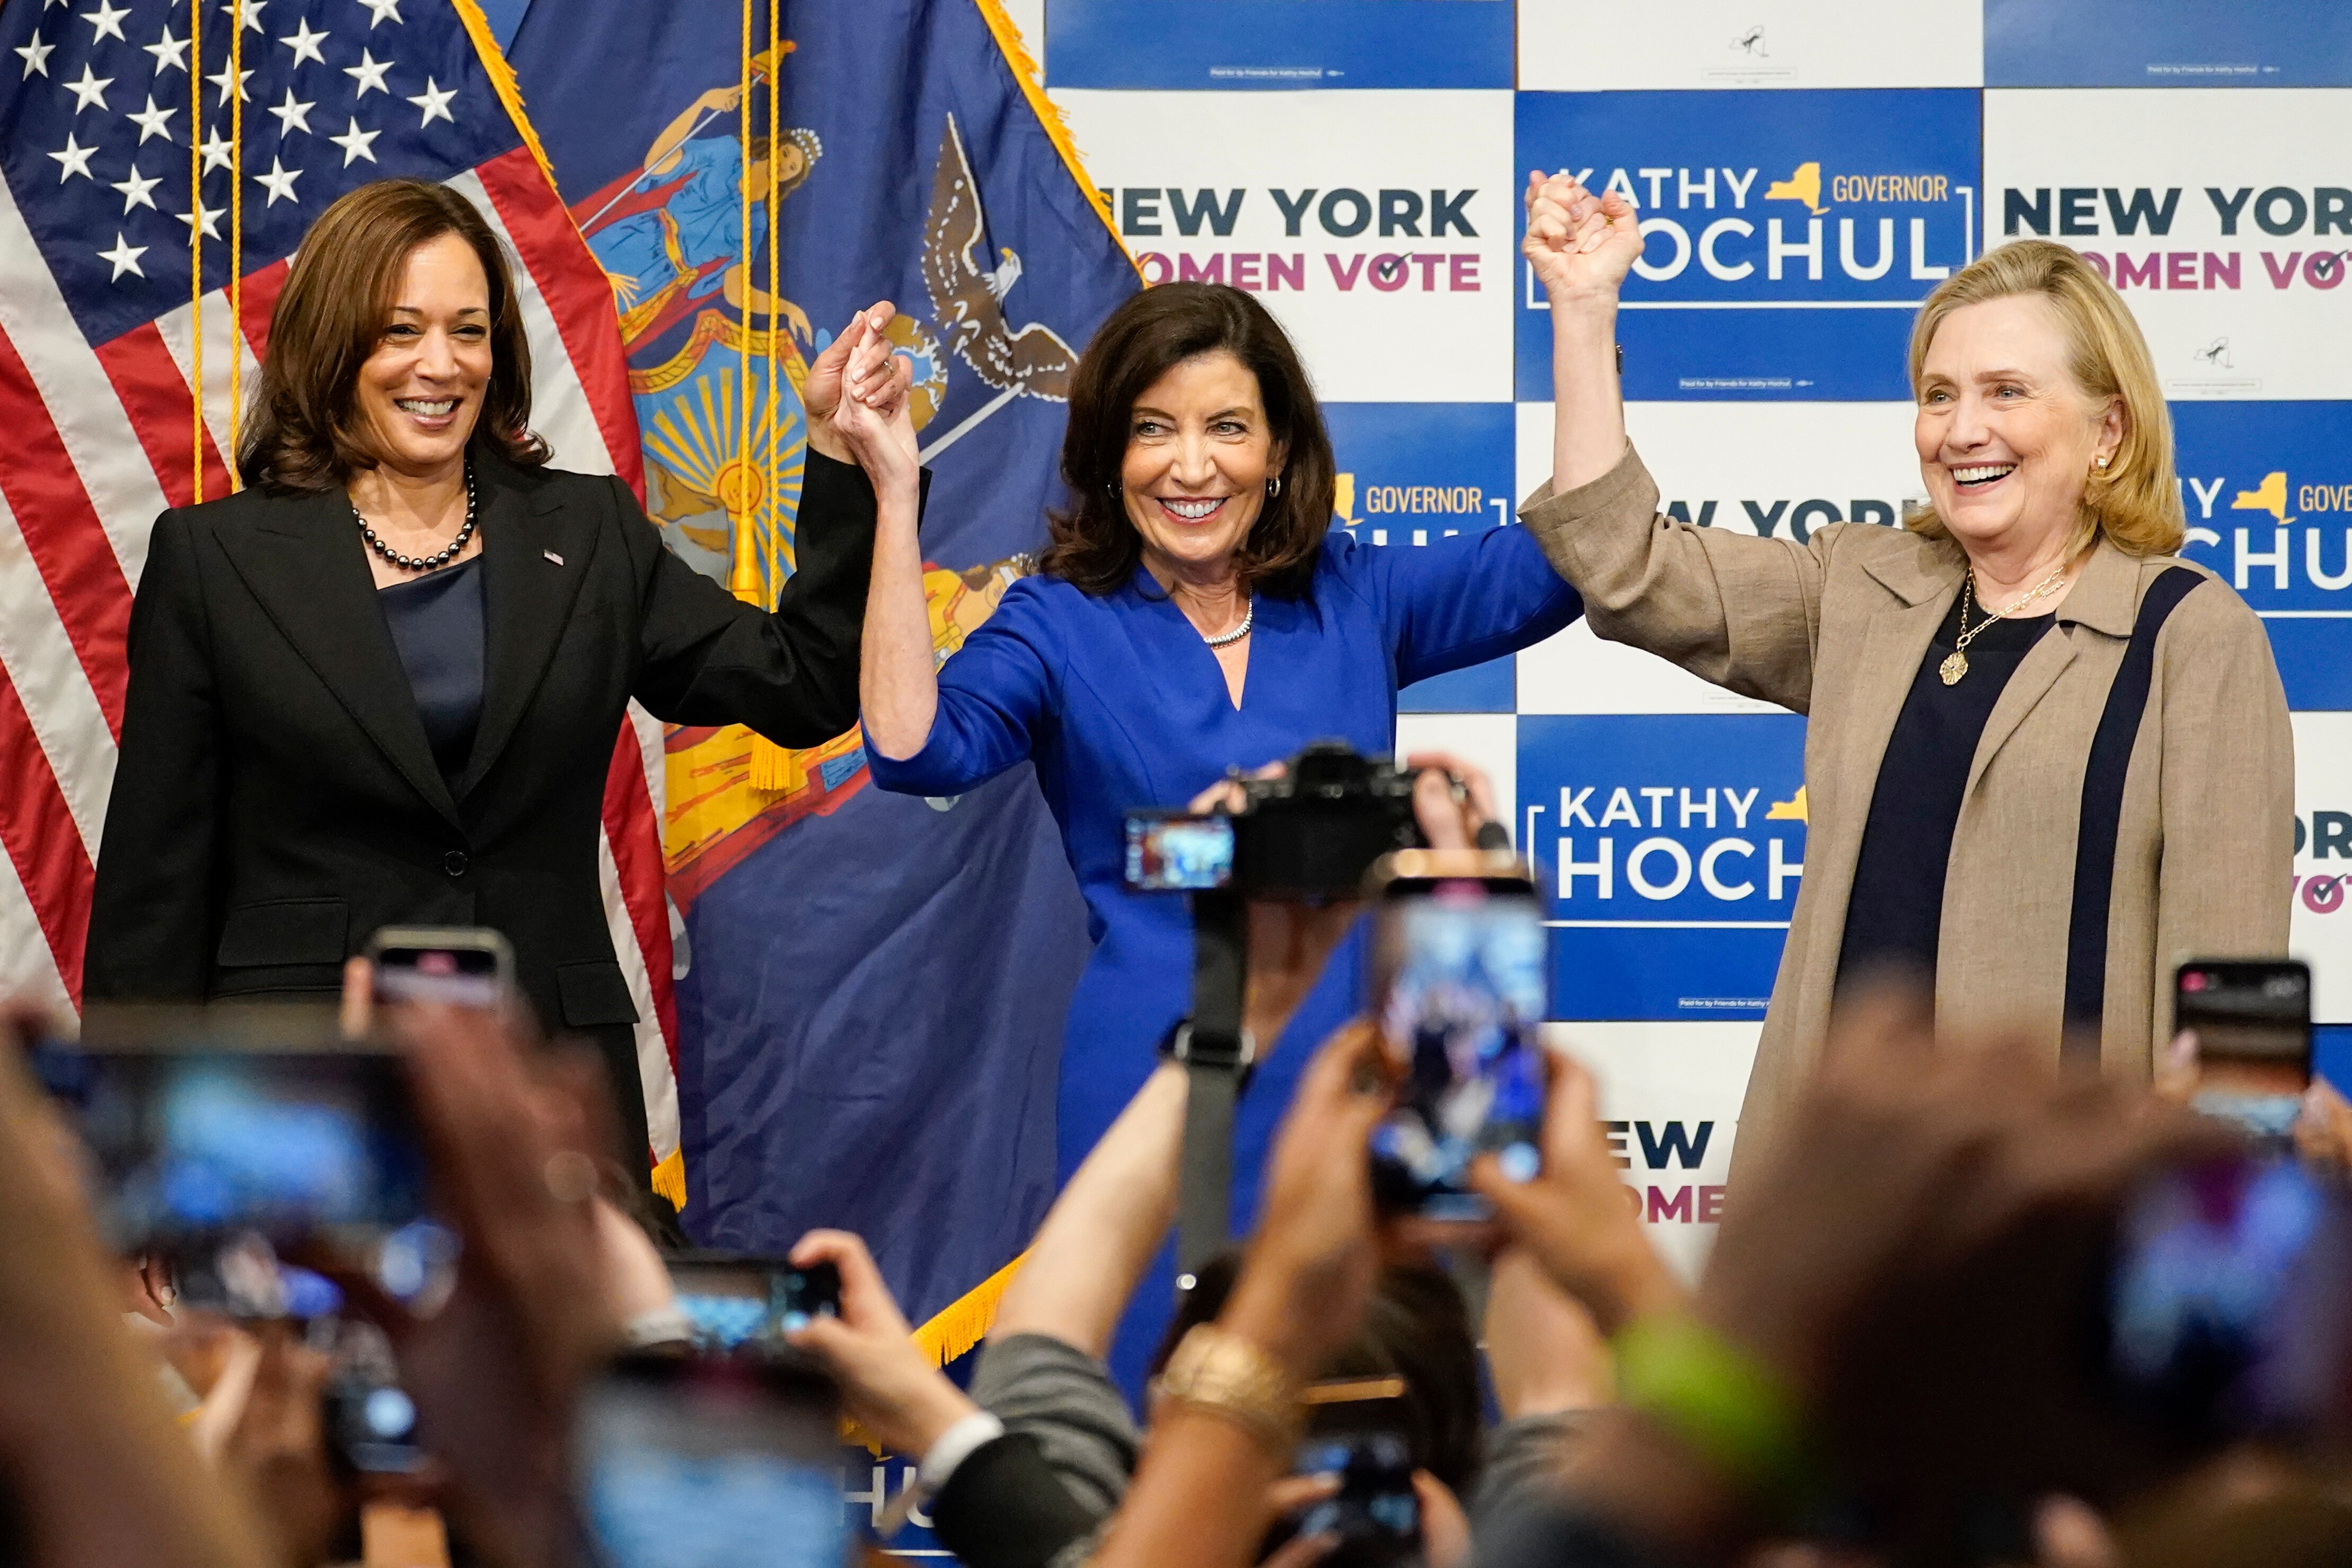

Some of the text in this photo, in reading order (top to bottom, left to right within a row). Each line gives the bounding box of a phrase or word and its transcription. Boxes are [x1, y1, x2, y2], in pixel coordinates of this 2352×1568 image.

[1833, 174, 1948, 202] GOVERNOR
[1270, 188, 1479, 237] YORK
[2004, 186, 2352, 237] NEW YOR
[1631, 217, 1950, 281] OCHUL
[2080, 249, 2352, 290] MEN VO
[1137, 251, 1482, 293] OMEN VOTE
[1366, 486, 1482, 514] GOVERNOR
[2299, 485, 2352, 512] GOVE
[1740, 499, 1917, 545] YO
[1560, 787, 1759, 829] KATHY
[1558, 837, 1804, 901] HOCH
[1598, 1121, 1715, 1169] EW
